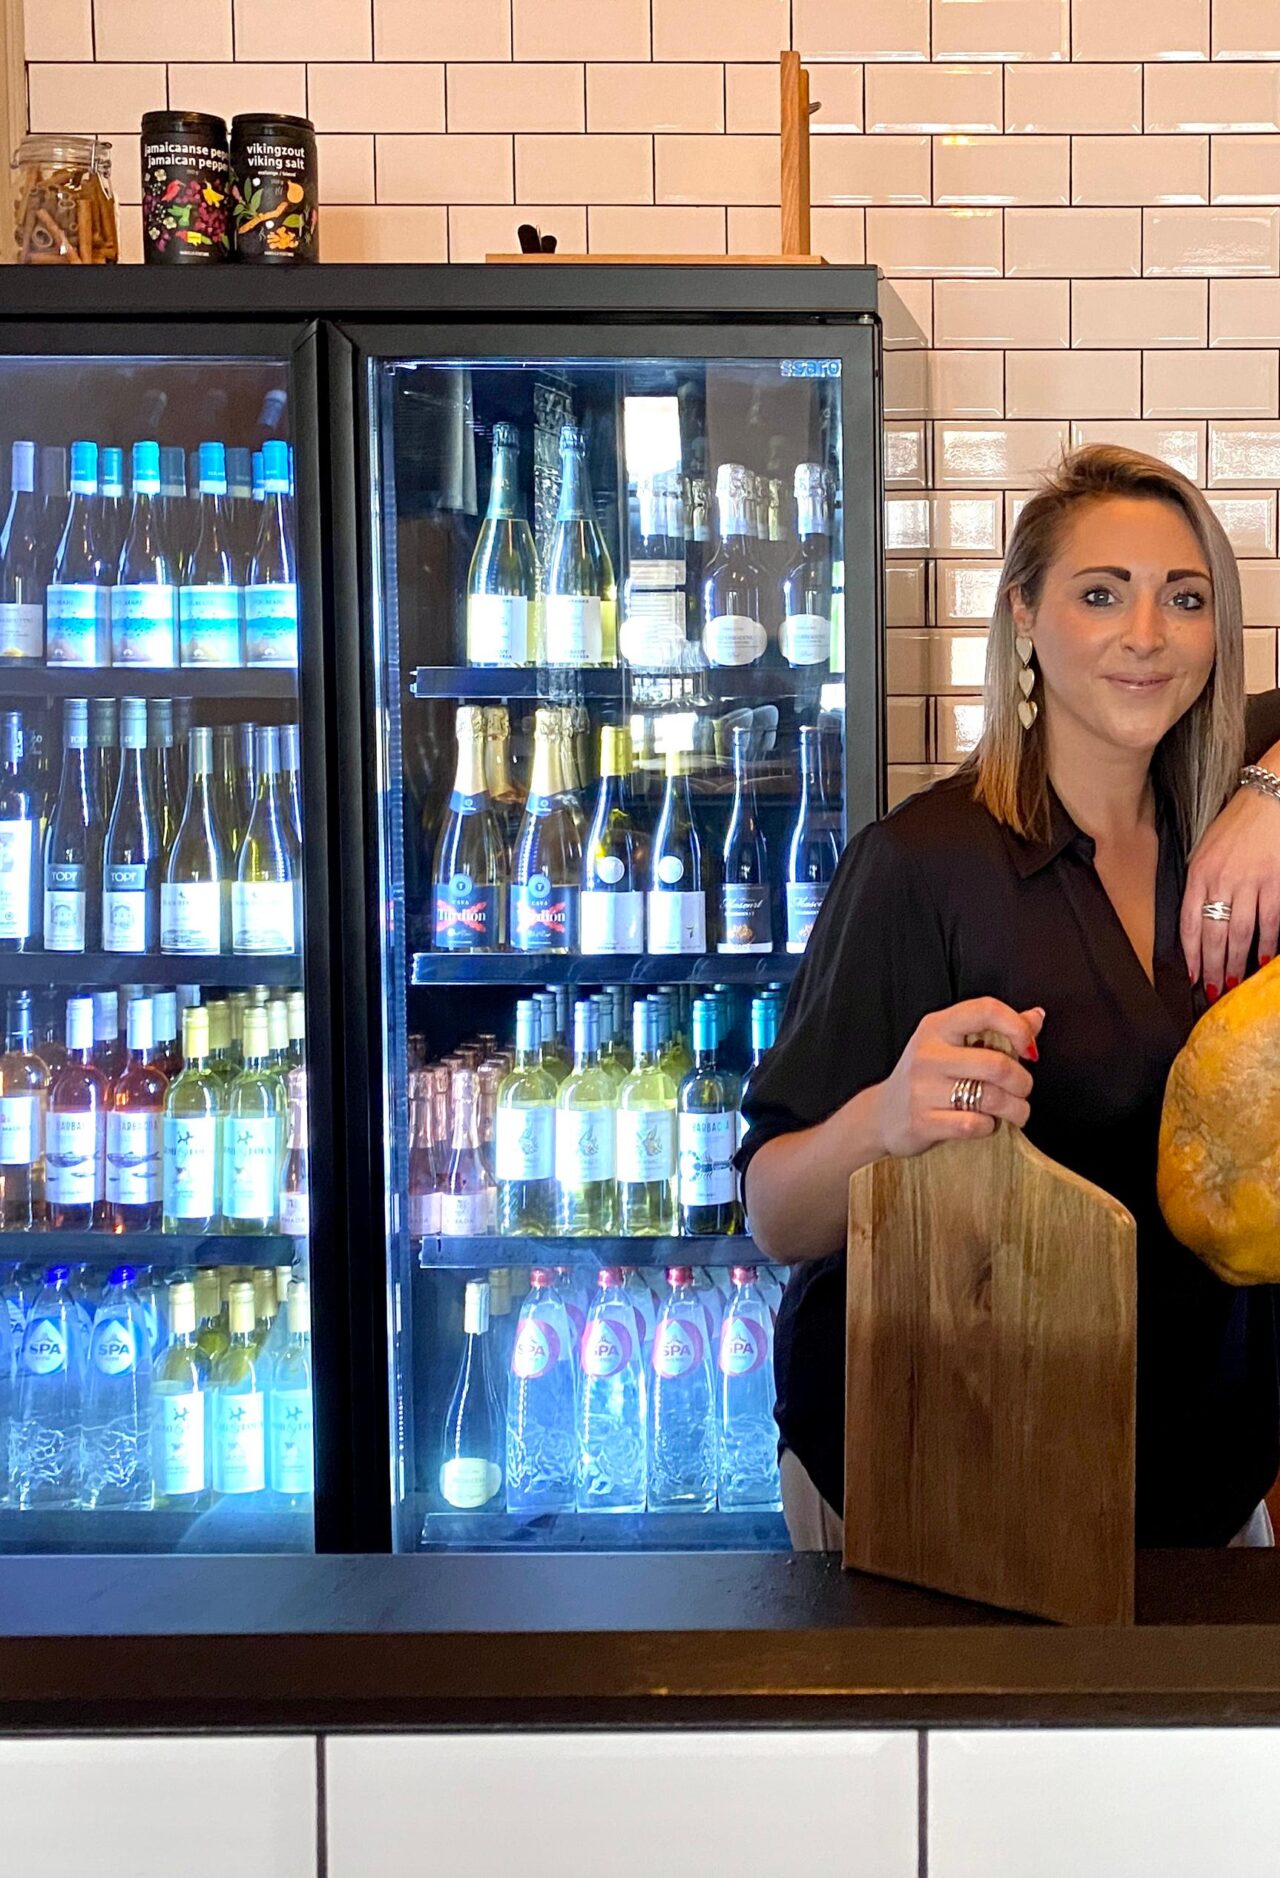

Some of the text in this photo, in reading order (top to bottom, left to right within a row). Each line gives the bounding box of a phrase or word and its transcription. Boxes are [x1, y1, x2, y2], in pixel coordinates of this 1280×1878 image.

[144, 141, 209, 157] jamaicaanse
[246, 143, 305, 158] vikingzout
[147, 154, 196, 169] jamaican
[247, 155, 305, 170] viking salt
[29, 1343, 61, 1355] SPA
[98, 1343, 130, 1356] SPA
[594, 1344, 620, 1357] PA
[664, 1344, 692, 1357] SPA
